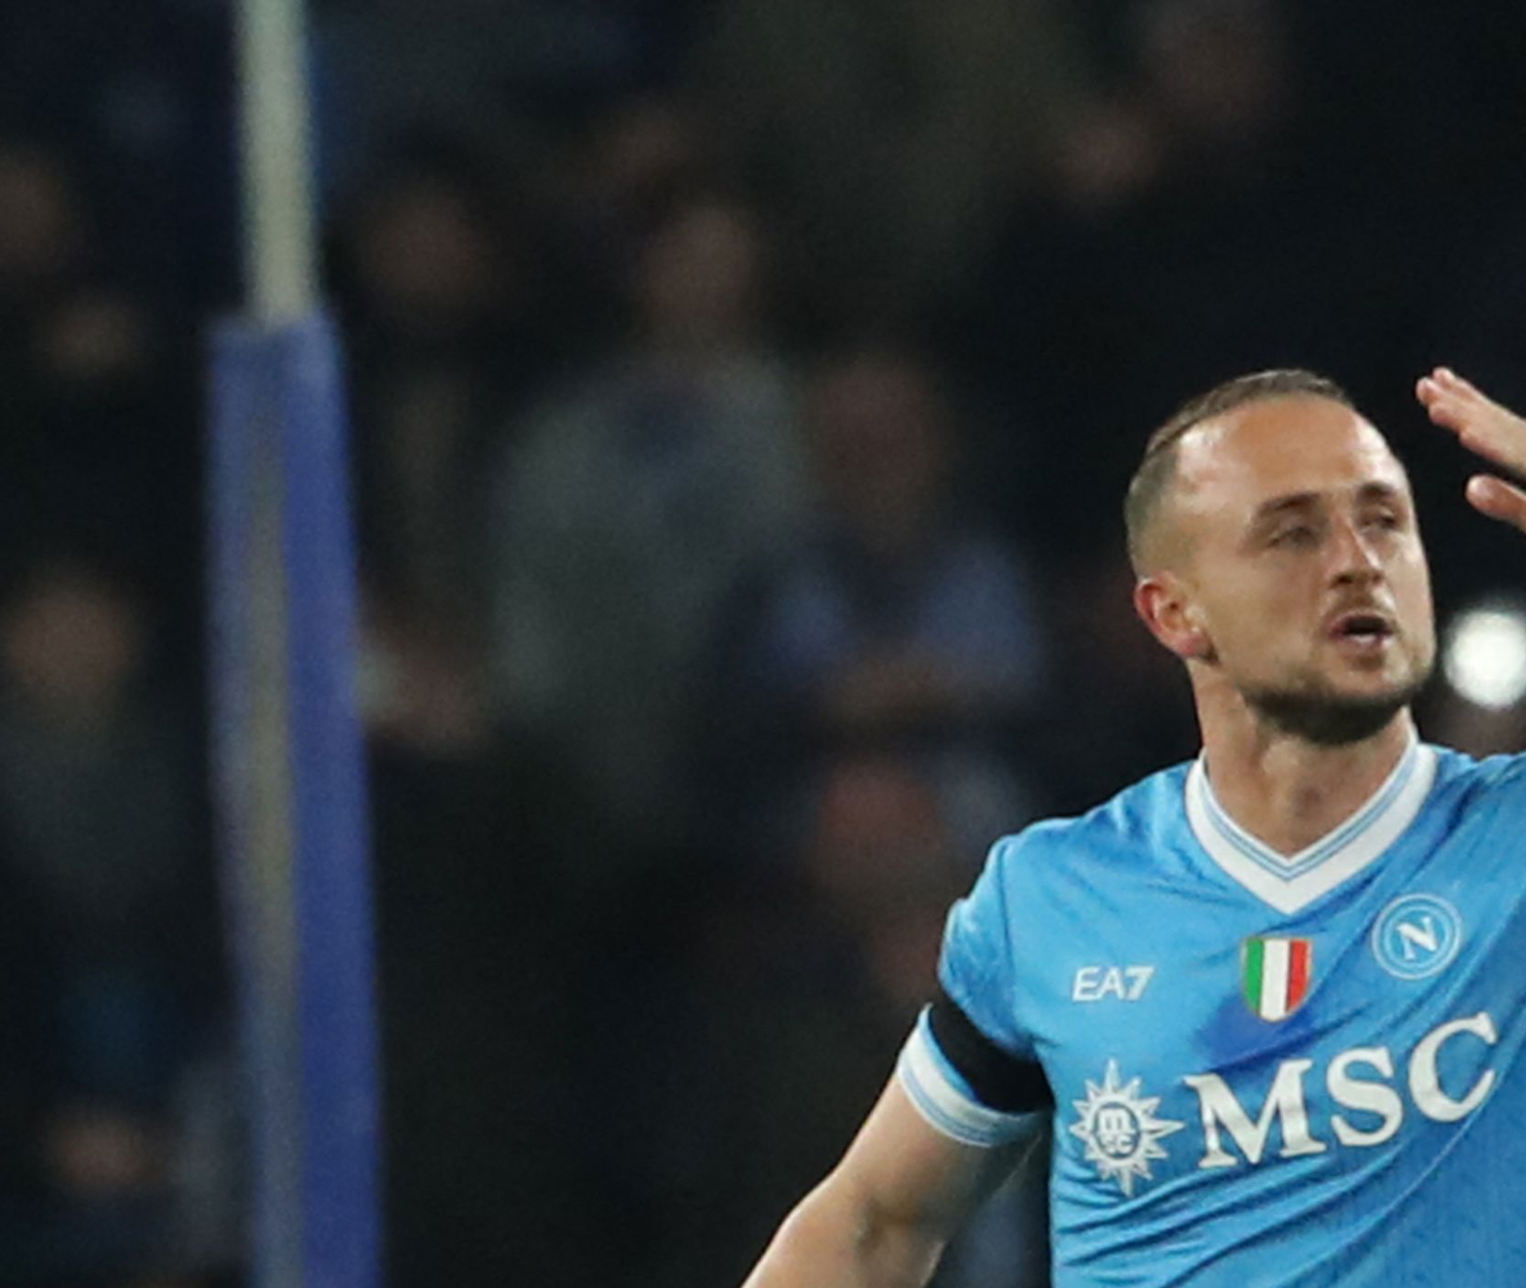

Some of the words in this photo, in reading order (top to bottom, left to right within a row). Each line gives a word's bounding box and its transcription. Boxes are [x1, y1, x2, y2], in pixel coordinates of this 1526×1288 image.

[1396, 917, 1439, 960] N
[1072, 965, 1154, 1001] EA7
[1184, 1011, 1497, 1168] MSC
